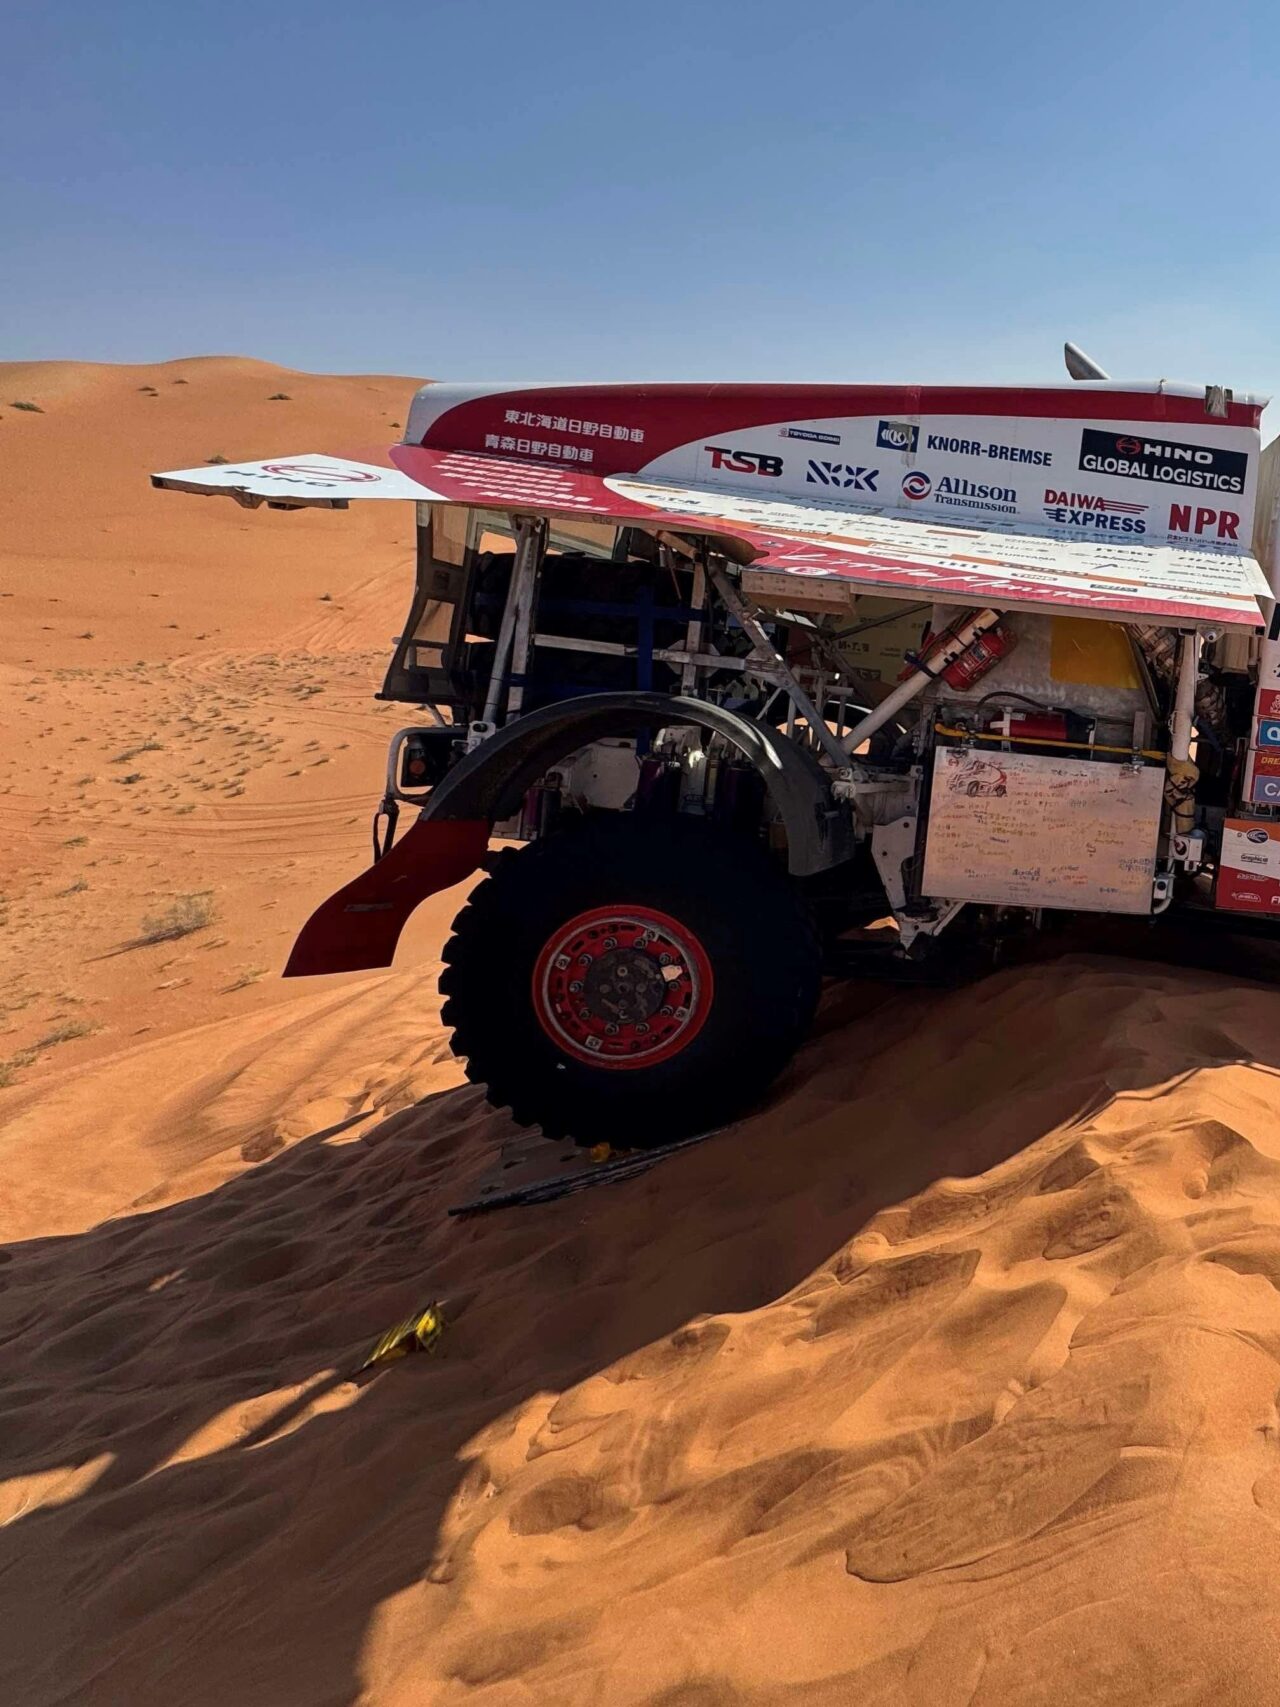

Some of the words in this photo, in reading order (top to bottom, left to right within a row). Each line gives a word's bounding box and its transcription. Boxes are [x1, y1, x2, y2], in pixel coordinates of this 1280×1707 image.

[504, 410, 645, 443] 東北海道日野自動車
[485, 434, 594, 462] 青森日野自動車
[704, 446, 784, 477] TSB
[927, 434, 1053, 467] KNORR-BREMSE
[1143, 443, 1213, 465] HINO
[806, 459, 880, 492] NOK
[1083, 454, 1149, 478] GLOBAL
[1153, 466, 1242, 492] LOGISTICS
[934, 493, 1017, 514] Transmission
[935, 476, 1017, 503] Allison
[1044, 488, 1106, 512] DAIWA
[1050, 507, 1146, 534] EXPRESS
[1168, 503, 1240, 540] NPR
